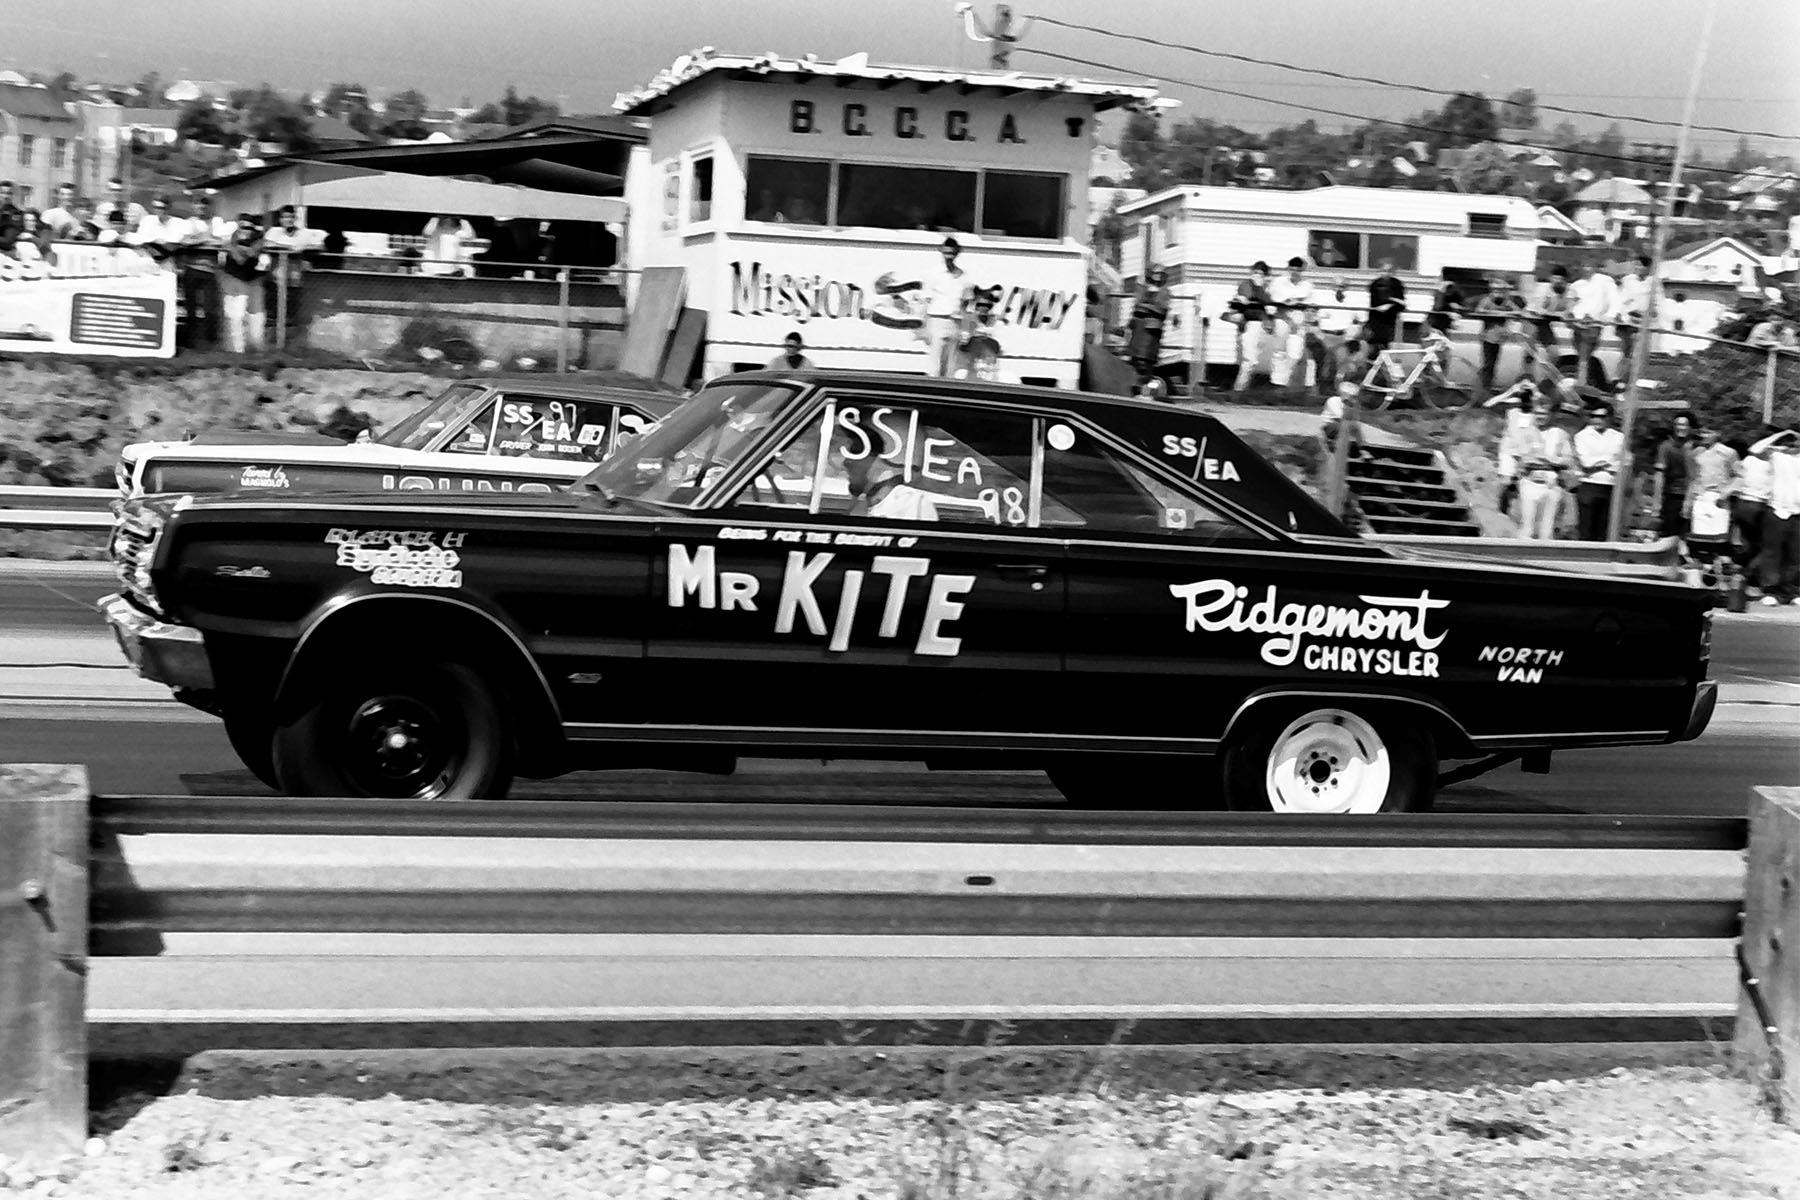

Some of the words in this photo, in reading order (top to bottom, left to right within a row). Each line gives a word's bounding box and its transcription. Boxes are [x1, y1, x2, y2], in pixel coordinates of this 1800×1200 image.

[728, 261, 865, 324] Mission
[978, 487, 1026, 526] 98
[772, 530, 803, 542] FOR
[805, 532, 831, 544] THE
[834, 533, 894, 546] BENEFIT
[898, 537, 919, 548] OF
[774, 550, 977, 656] KITE
[1169, 579, 1451, 666] Ridgemont
[1304, 644, 1440, 678] CHRYSLER
[1478, 646, 1564, 666] NORTH
[1497, 667, 1543, 684] VAN
